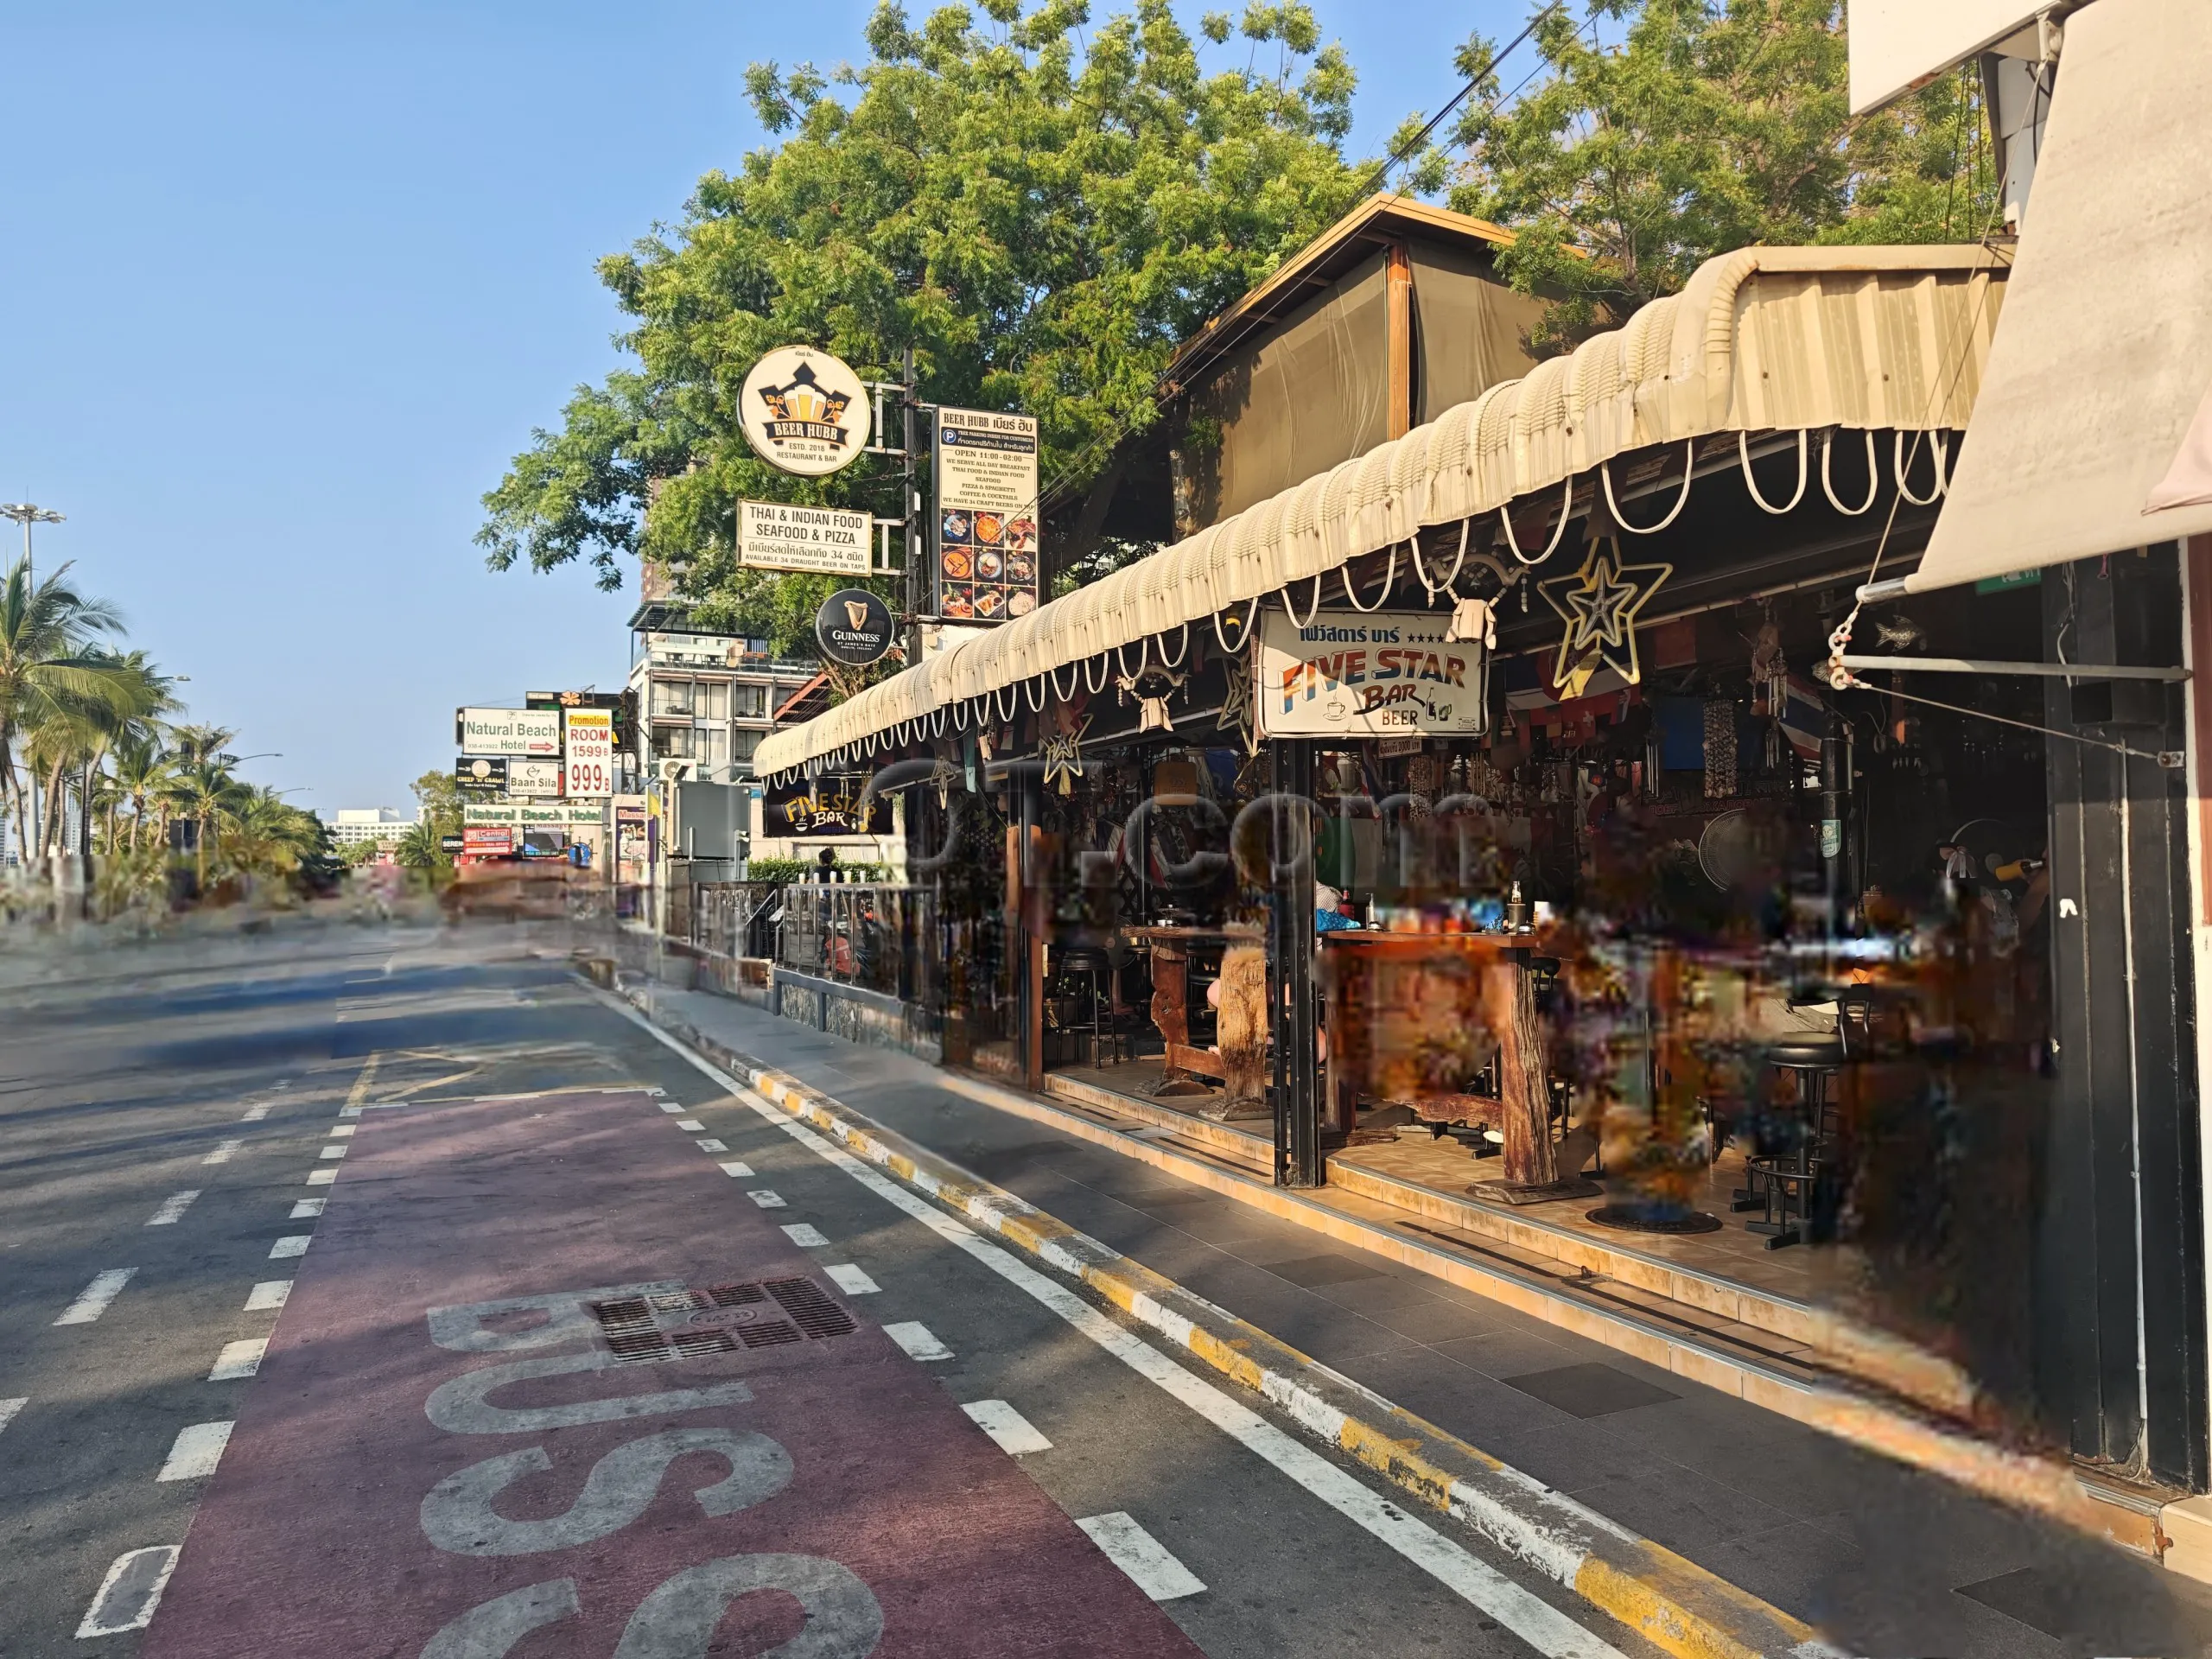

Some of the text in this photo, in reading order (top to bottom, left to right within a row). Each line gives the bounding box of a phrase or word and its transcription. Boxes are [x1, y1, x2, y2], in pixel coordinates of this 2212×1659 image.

[944, 413, 988, 427] BEER HUBB
[993, 417, 1033, 432] เบียร์ ฮับ
[774, 423, 838, 440] BEER HUBB
[777, 451, 817, 461] RESTAURANT
[750, 506, 862, 529] THAI & INDIAN FOOD
[756, 524, 855, 544] SEAFOOD & PIZZA
[831, 550, 842, 560] 34
[847, 551, 863, 562] ชนิด
[832, 630, 880, 642] GUINNESS
[1372, 626, 1400, 643] บาร์
[1279, 648, 1465, 715] FIVE STAR
[1353, 684, 1426, 715] BAR
[569, 715, 608, 725] Promotion
[1382, 710, 1418, 726] BEER
[467, 721, 556, 736] Natural Beach
[570, 729, 608, 741] ROOM
[501, 740, 526, 749] Hotel
[572, 746, 601, 757] 1599
[511, 778, 556, 787] Baan Sila
[572, 764, 601, 791] 999
[467, 809, 601, 821] Natural Beach Hotel
[619, 810, 653, 819] Massae
[812, 811, 849, 828] BAR
